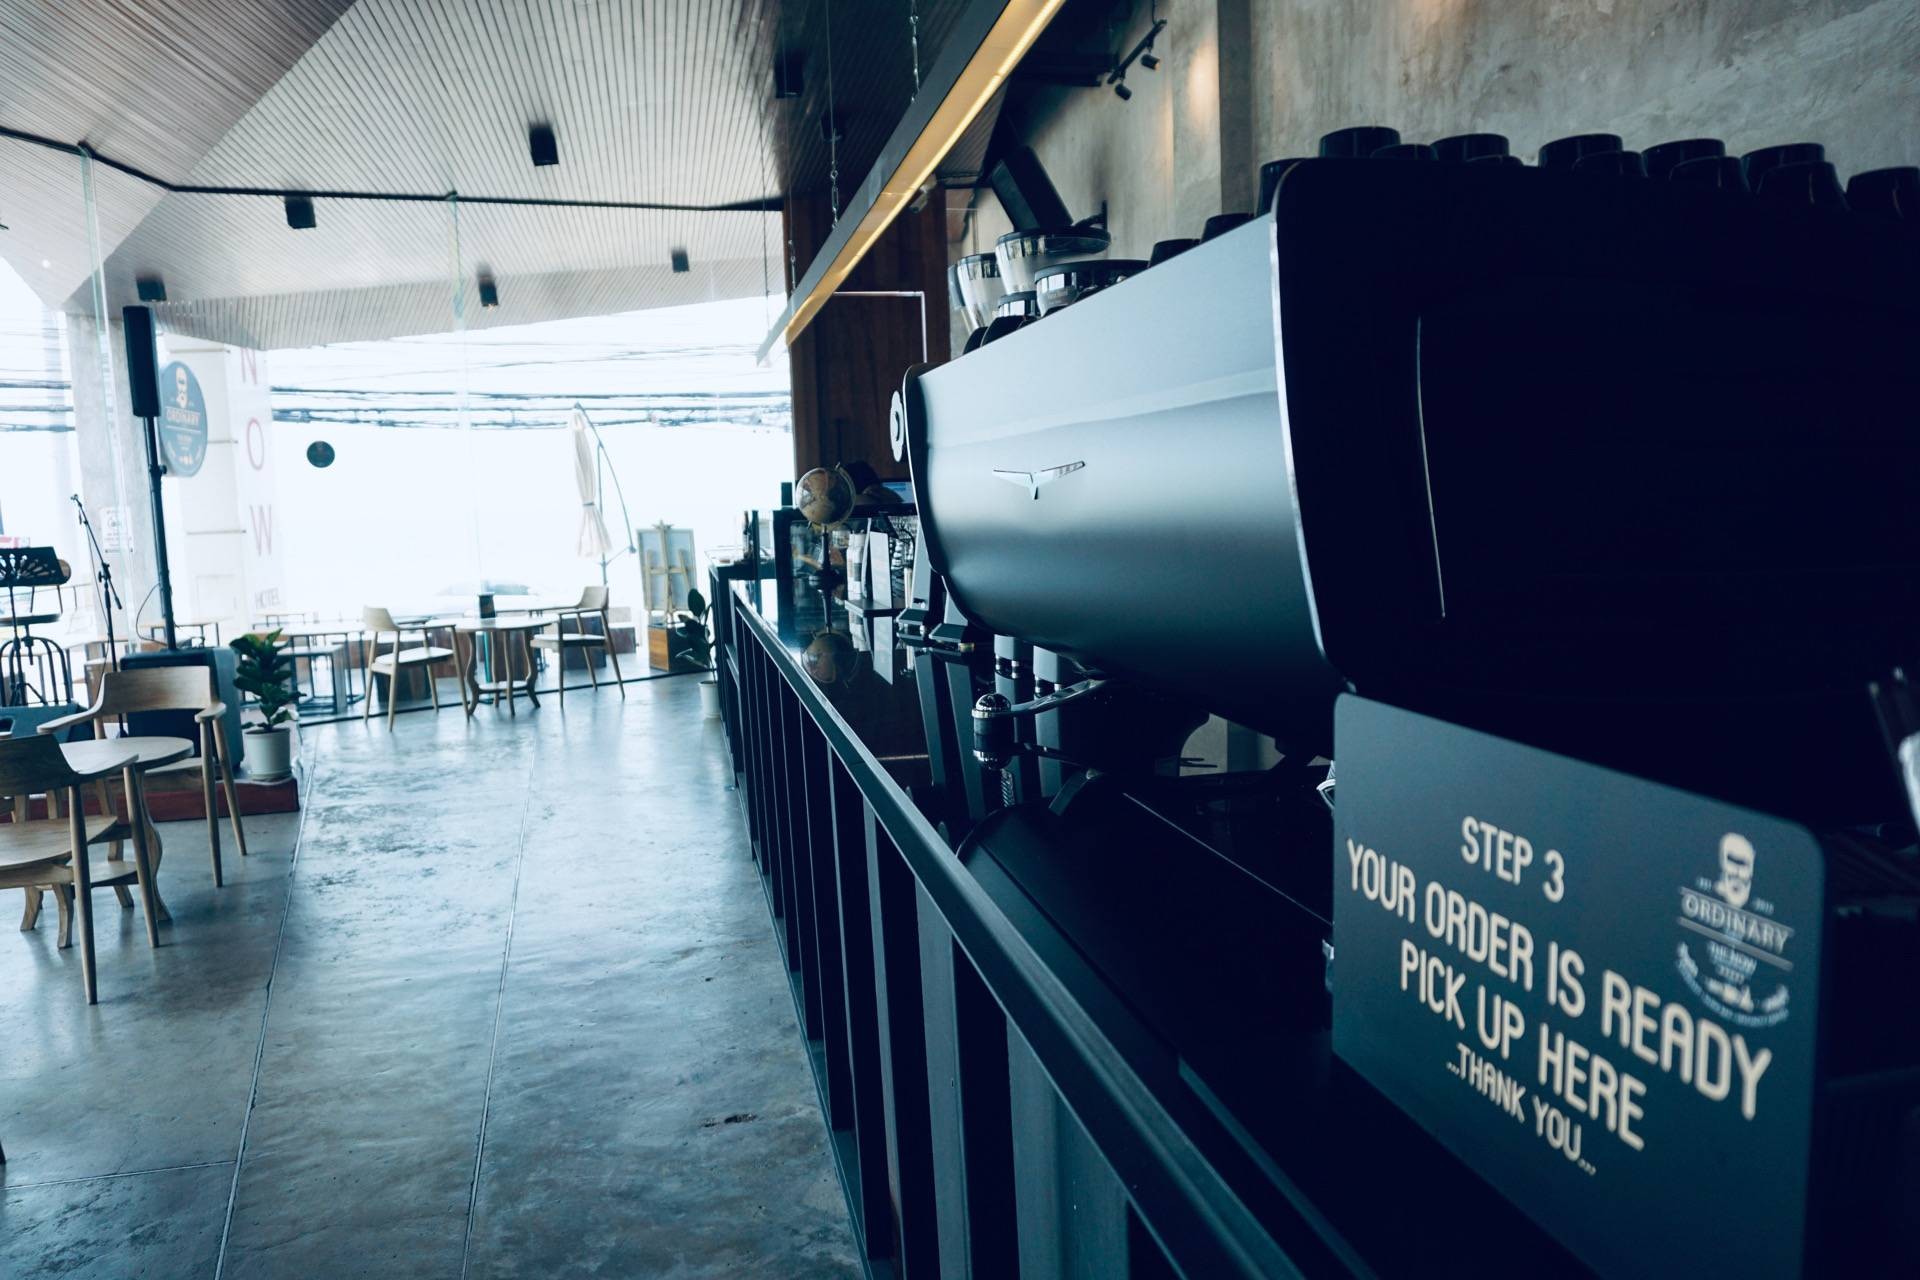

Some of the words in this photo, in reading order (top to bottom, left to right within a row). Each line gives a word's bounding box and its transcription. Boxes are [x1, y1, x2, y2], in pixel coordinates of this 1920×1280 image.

[1461, 816, 1533, 885] STEP
[1543, 849, 1565, 902] 3
[1682, 893, 1789, 954] ORDINARY
[1347, 838, 1416, 924] YOUR
[1425, 881, 1534, 992] ORDER
[1547, 941, 1586, 1018] IS
[1601, 969, 1772, 1121] READY
[1400, 939, 1466, 1030] PICK
[1477, 985, 1525, 1059] UP
[1538, 1022, 1647, 1151] HERE
